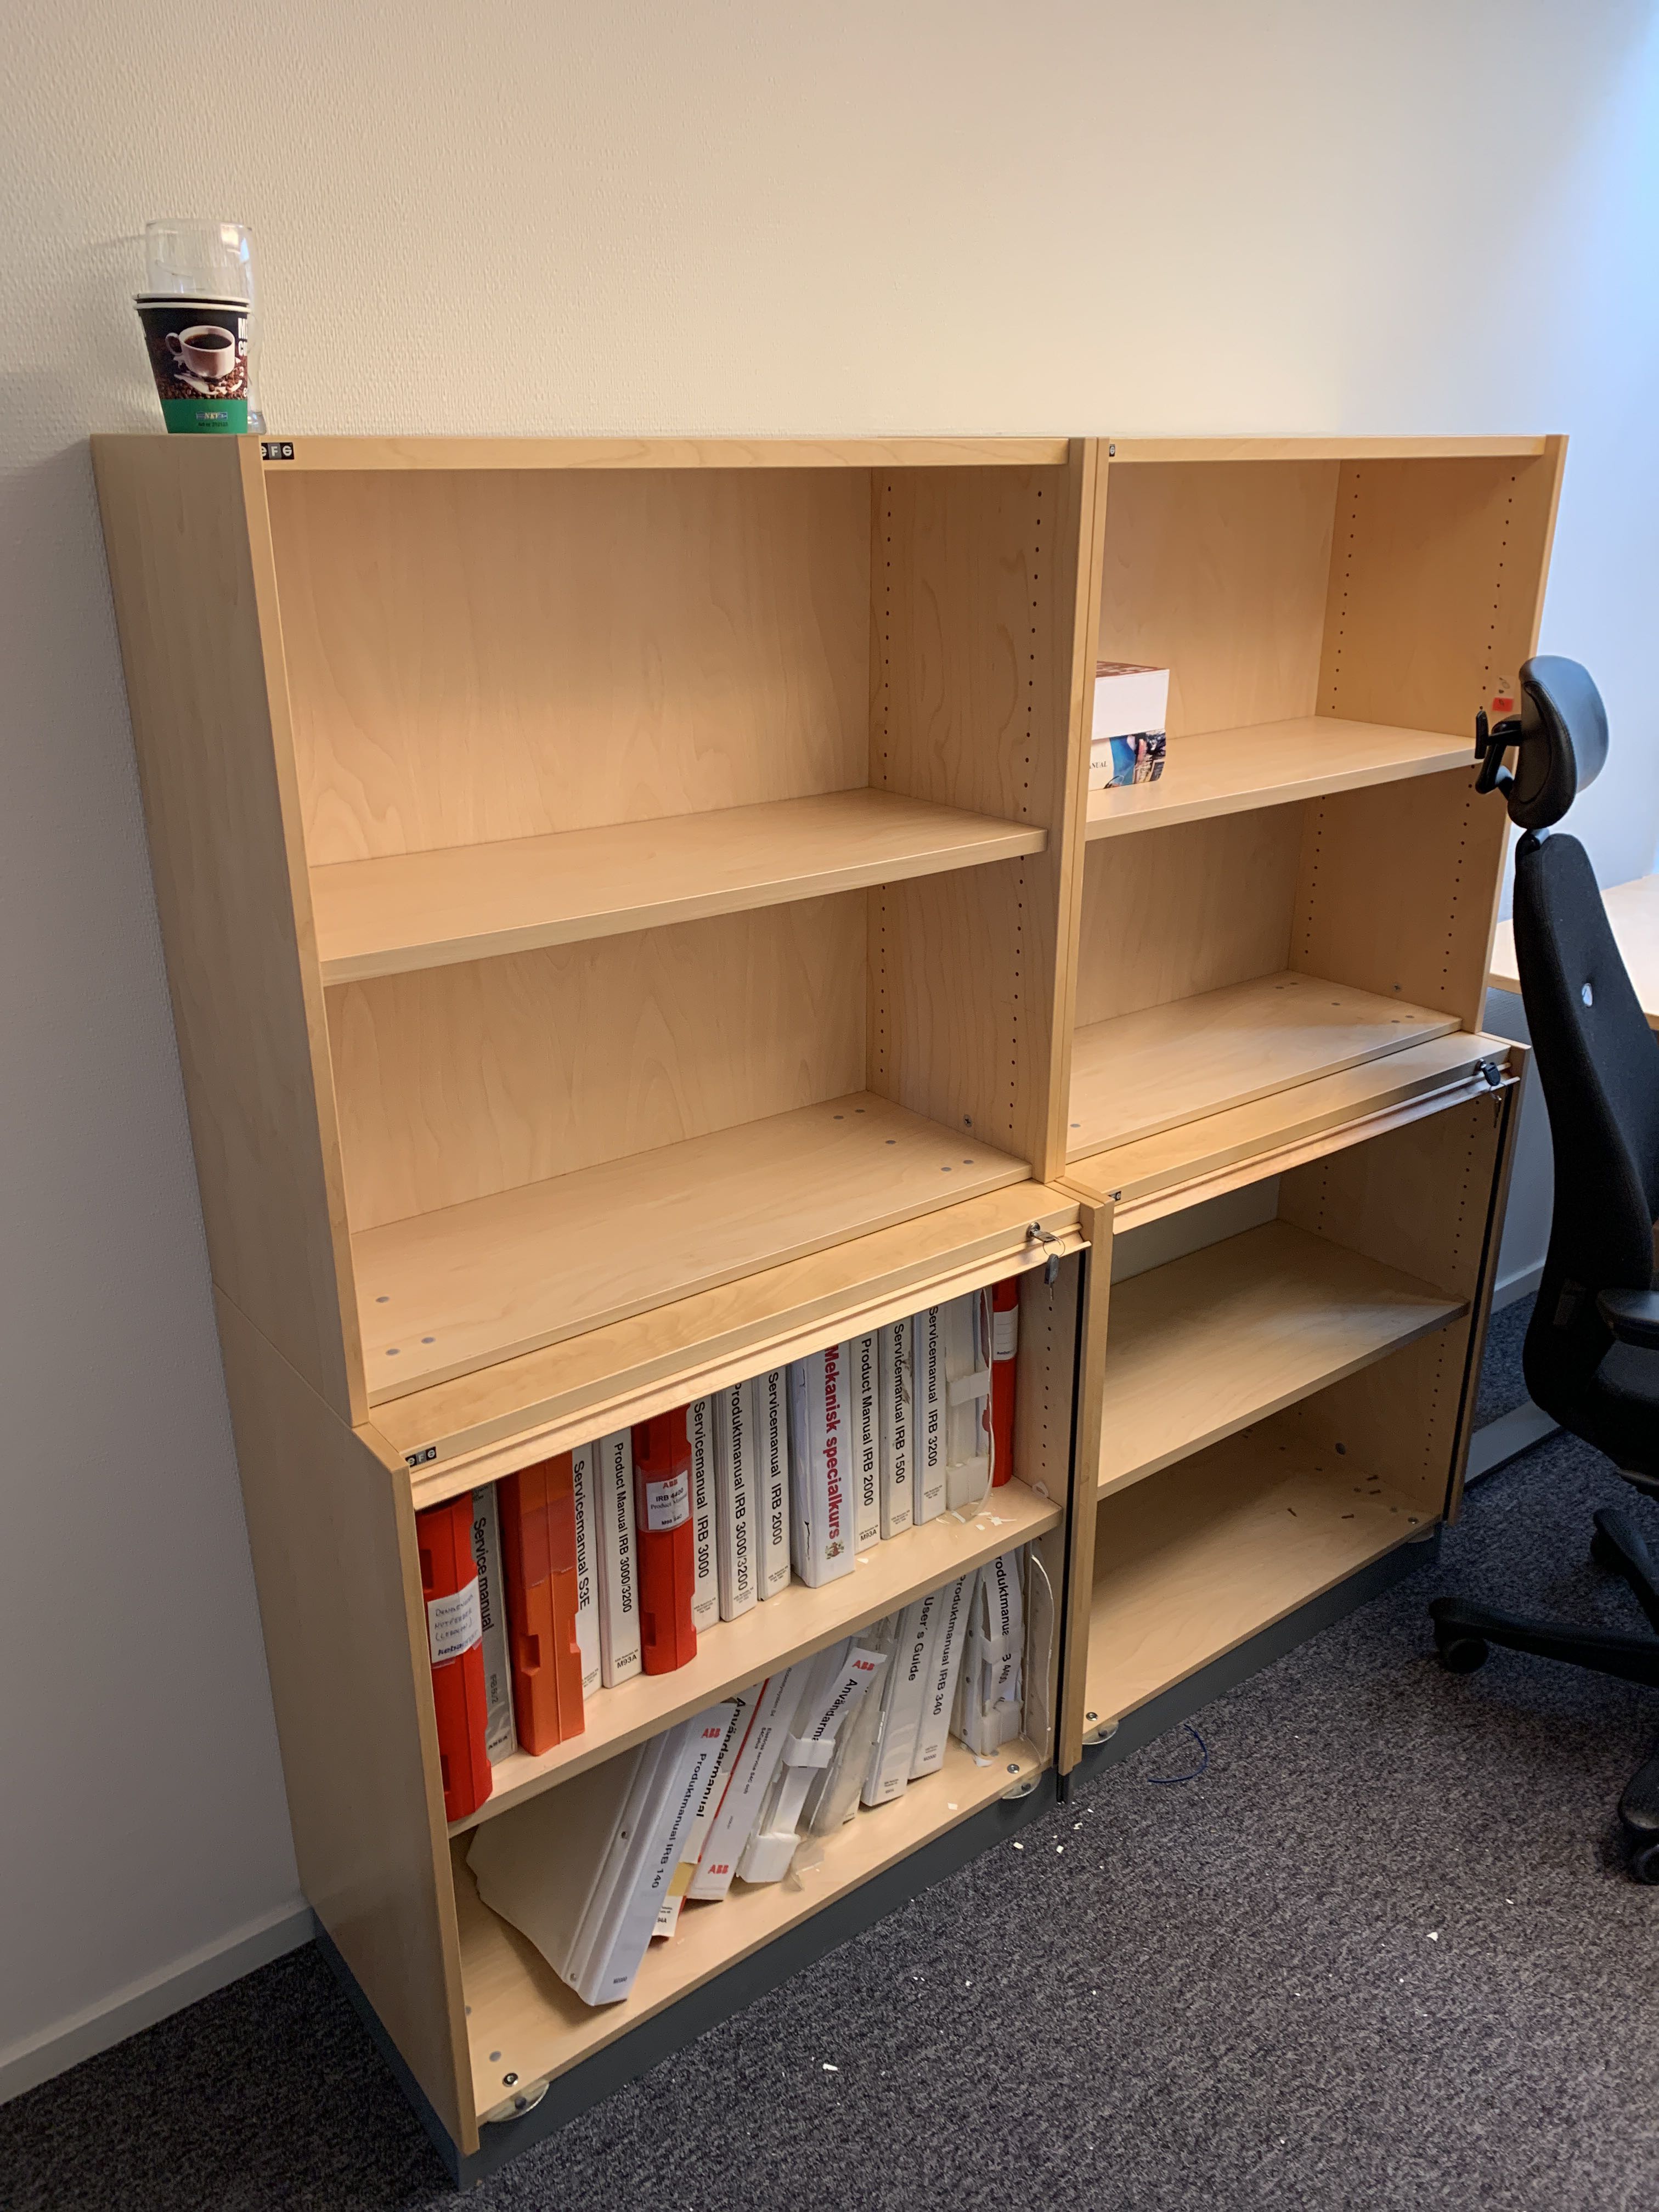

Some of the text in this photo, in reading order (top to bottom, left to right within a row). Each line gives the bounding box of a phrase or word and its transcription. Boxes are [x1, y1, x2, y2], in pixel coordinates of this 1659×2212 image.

[1090, 761, 1107, 769] NUAL
[894, 1323, 905, 1484] Servicemanual IRB 1500
[928, 1306, 938, 1467] Servicemanual IRB 3200
[823, 1345, 843, 1539] Mekanisk specialkurs
[861, 1338, 873, 1506] Product Manual IRB 2000
[663, 1479, 678, 1489] ABB
[768, 1371, 782, 1545] Servicemanual IRB 2000
[651, 1502, 672, 1510] Product
[694, 1401, 709, 1578] Servicemanual IRB 3000
[735, 1493, 746, 1520] IRB
[473, 1517, 489, 1576] Service
[574, 1460, 590, 1611] Servicemanual S3E
[614, 1442, 632, 1613] Product Manual IRB 3000/3200
[736, 1521, 748, 1591] 3000/3200
[479, 1576, 495, 1632] manual
[995, 1556, 1009, 1637] roduktmanua
[617, 1654, 637, 1669] M93A
[852, 1660, 875, 1671] ABB
[909, 1643, 924, 1681] Guide
[937, 1668, 948, 1691] IRB
[933, 1693, 944, 1716] 340
[701, 1728, 721, 1739] ABB
[651, 1753, 707, 1889] Produktmanual IRB 140
[708, 1864, 729, 1875] ABB
